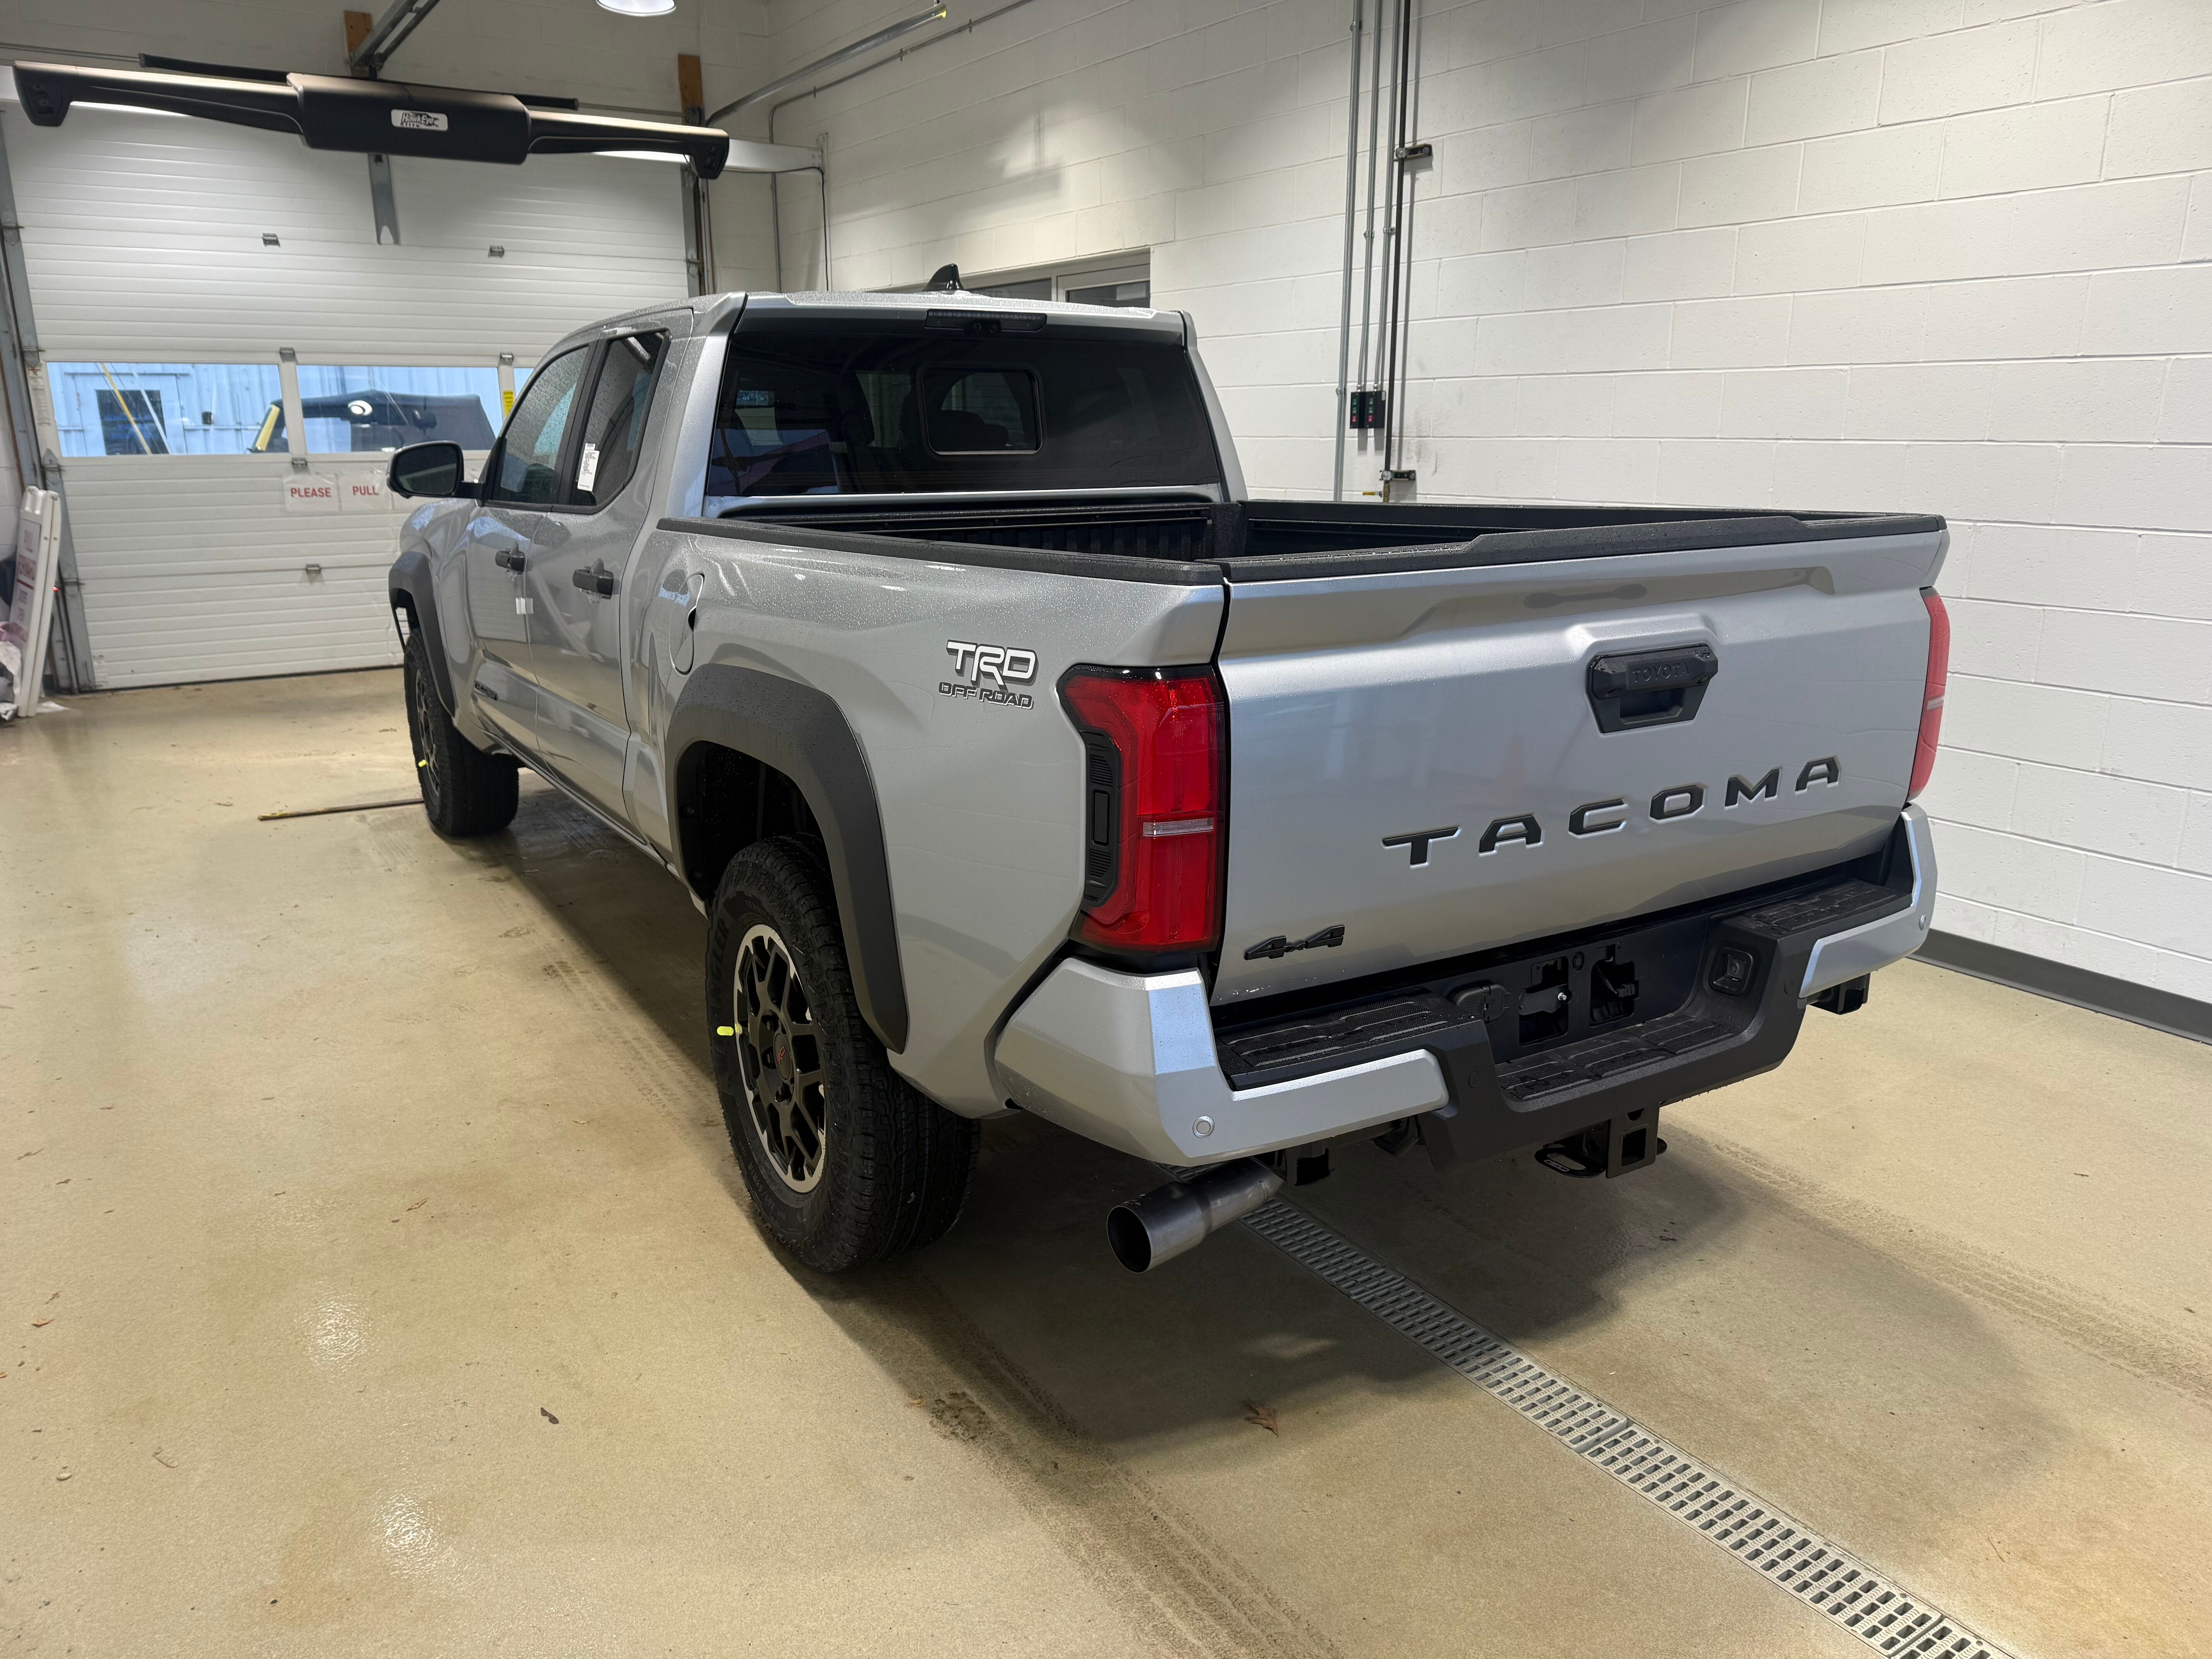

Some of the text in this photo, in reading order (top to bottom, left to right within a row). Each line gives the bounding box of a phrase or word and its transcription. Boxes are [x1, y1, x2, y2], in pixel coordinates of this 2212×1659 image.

[290, 486, 379, 498] PLEASE PULL
[946, 639, 1039, 690] TRD
[1631, 661, 1690, 683] TOYOTA
[939, 682, 1034, 710] OFF ROAD
[1382, 755, 1842, 868] TACOMA
